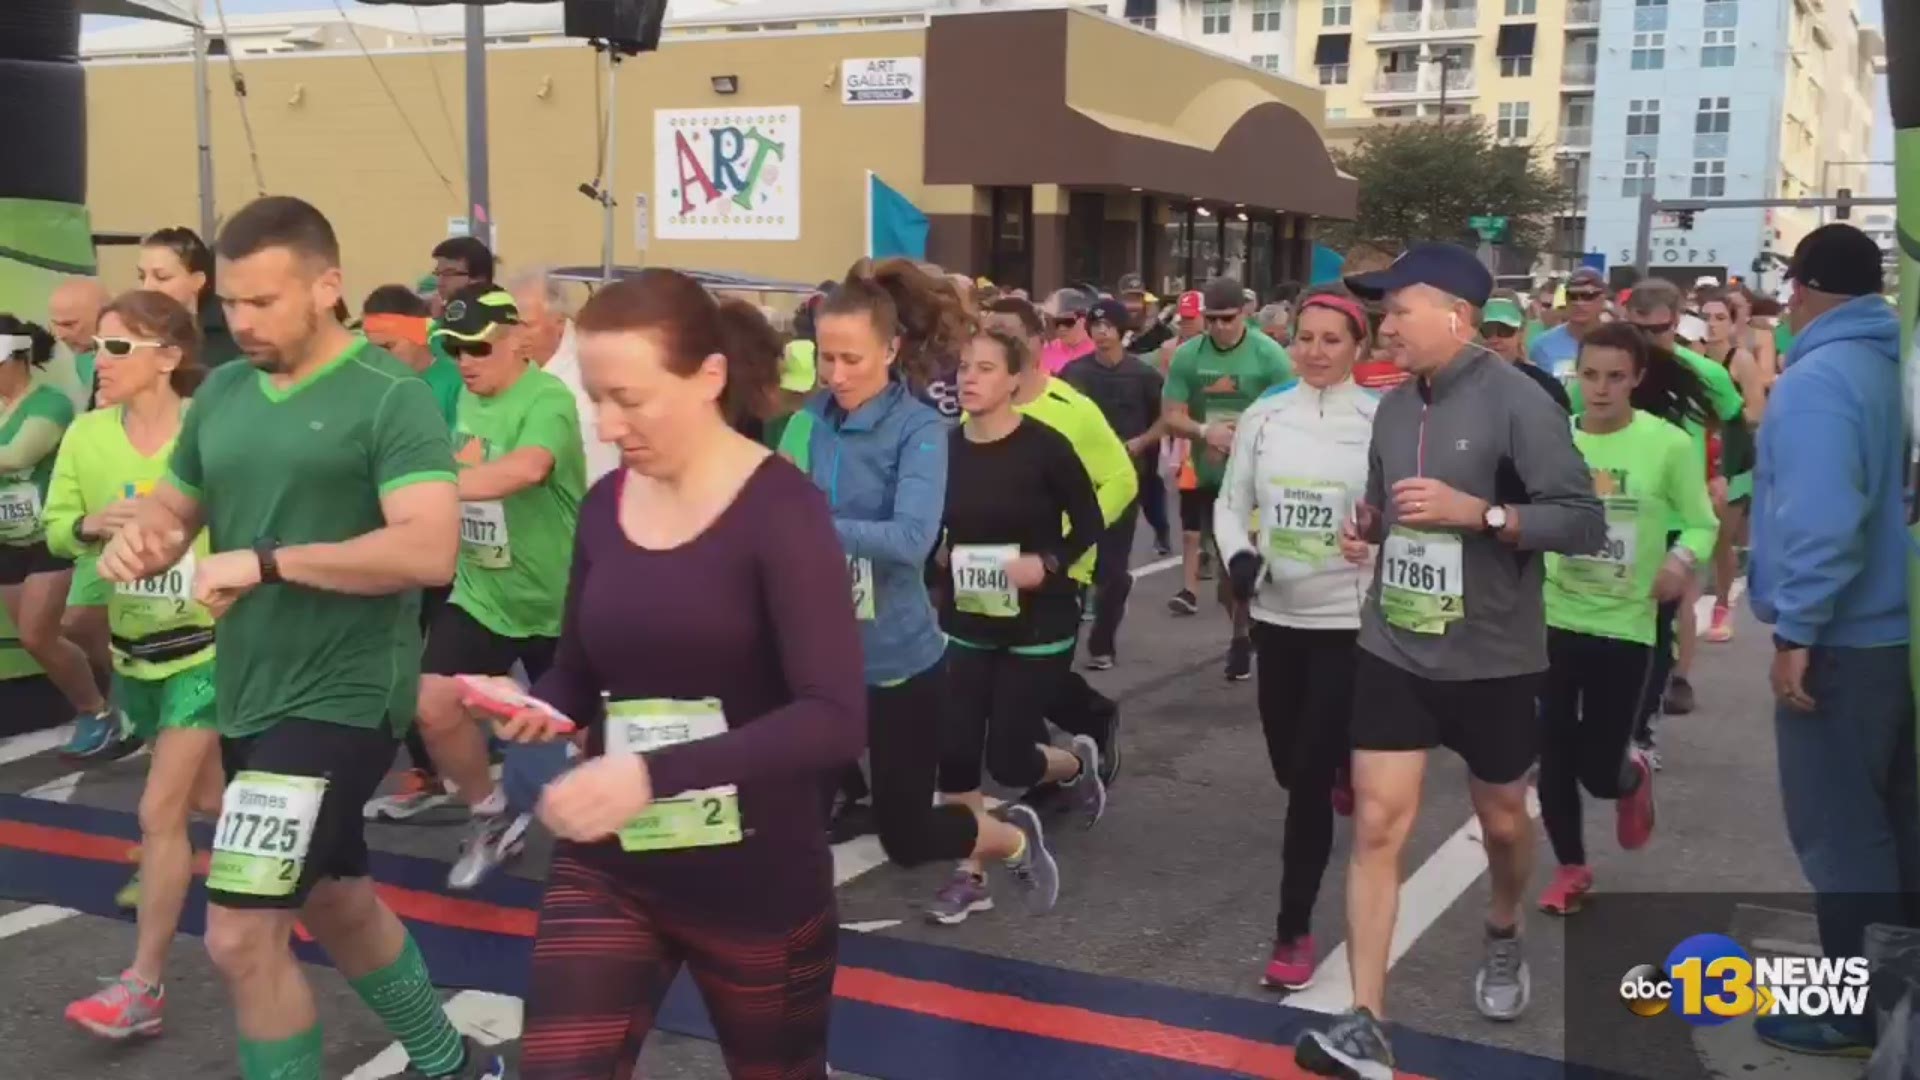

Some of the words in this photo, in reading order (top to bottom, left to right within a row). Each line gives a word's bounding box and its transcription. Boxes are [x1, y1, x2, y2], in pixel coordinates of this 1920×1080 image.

[866, 60, 896, 72] ART
[847, 73, 912, 87] GALLERY
[674, 126, 785, 216] ART
[1653, 237, 1687, 246] THE
[1274, 503, 1333, 529] 17922
[1325, 532, 1335, 547] 2
[957, 566, 1009, 591] 17840
[1387, 557, 1446, 592] 17861
[174, 600, 187, 615] 2
[1440, 595, 1455, 613] 2
[701, 797, 724, 826] 2
[220, 811, 301, 853] 17725
[278, 858, 296, 881] 2
